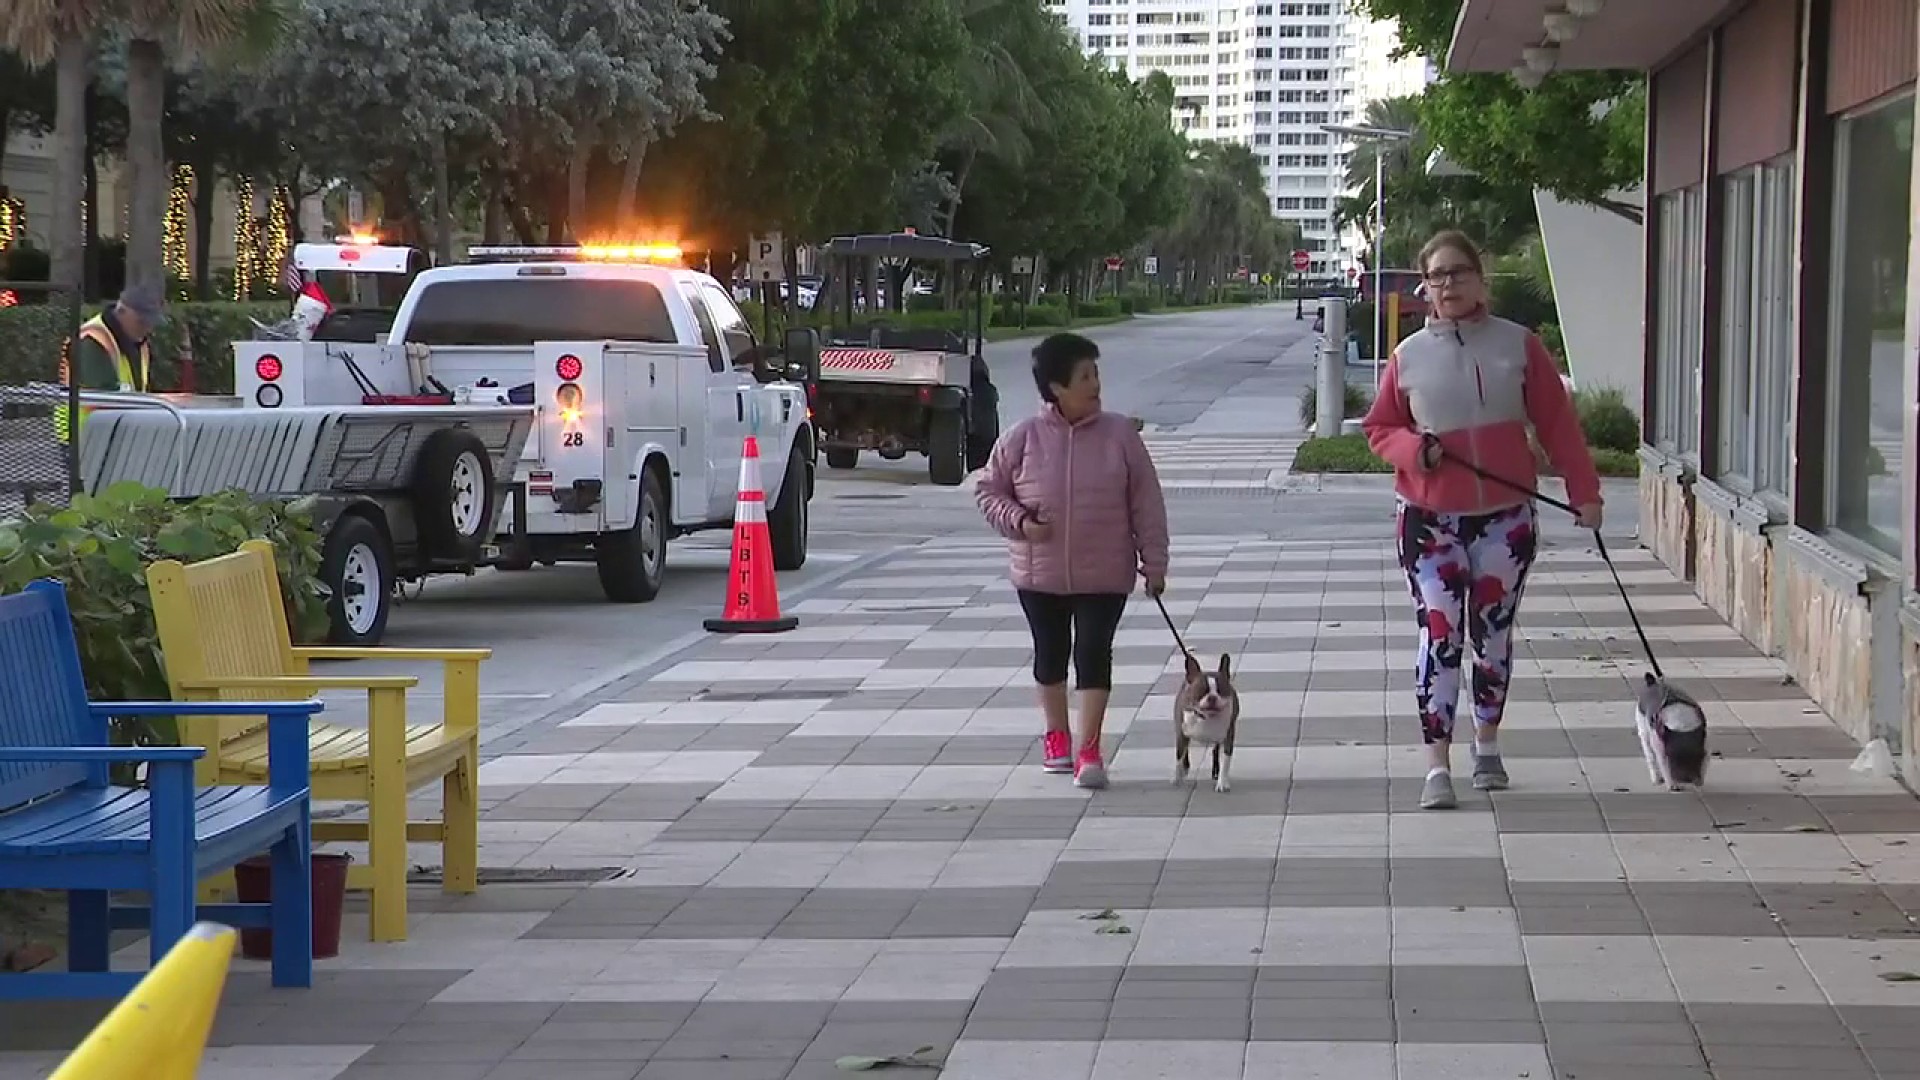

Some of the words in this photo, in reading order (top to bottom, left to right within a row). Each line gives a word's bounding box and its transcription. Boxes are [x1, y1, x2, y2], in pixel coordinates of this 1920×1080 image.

[760, 242, 772, 259] P
[563, 431, 584, 448] 28
[738, 525, 751, 607] LBTS
